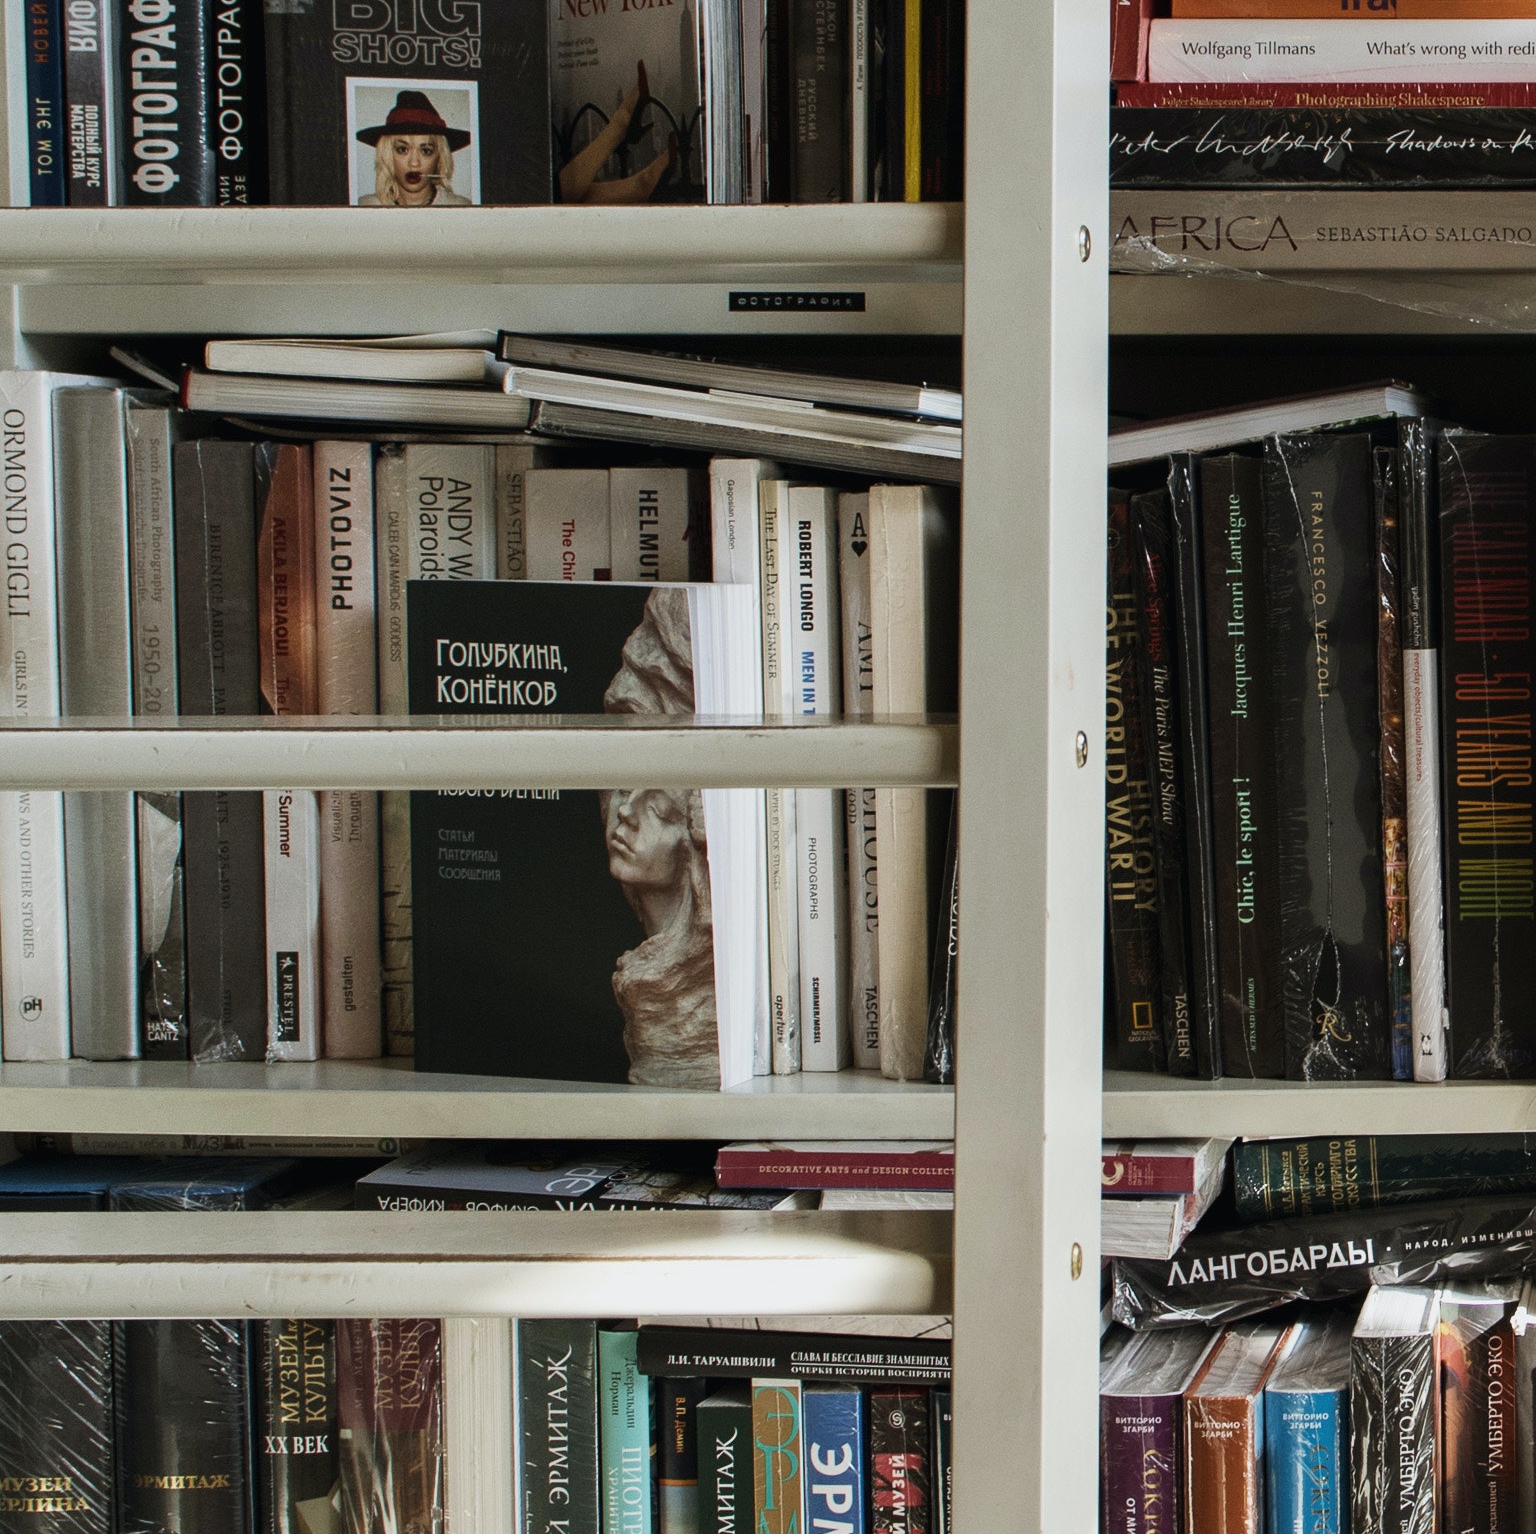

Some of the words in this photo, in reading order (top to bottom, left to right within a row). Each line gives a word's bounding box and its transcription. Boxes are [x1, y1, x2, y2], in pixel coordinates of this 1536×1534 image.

[332, 34, 482, 67] SHOTS!
[1181, 40, 1252, 59] Wolfgang
[1255, 40, 1316, 57] Tillmans
[1419, 42, 1469, 61] wrong
[1472, 40, 1502, 57] with
[1112, 214, 1299, 253] AFRICA
[1316, 224, 1428, 243] SEBASTIÃO
[1435, 225, 1532, 243] SALGADO
[4, 406, 29, 536] ORMOND
[329, 467, 354, 611] PHOTOVIZ
[1224, 493, 1248, 575] Lartigue
[6, 543, 30, 620] GIGLI
[1226, 583, 1245, 638] Henri
[435, 638, 568, 673] ГОЛУБКИНА,
[435, 674, 557, 706] КОНЁНКОВ
[1230, 643, 1252, 719] Jacques
[1166, 1237, 1375, 1287] ЛАНГОБАРДЫ
[292, 1435, 329, 1455] ВЕК
[547, 1343, 573, 1505] ЭРМИТАЖ
